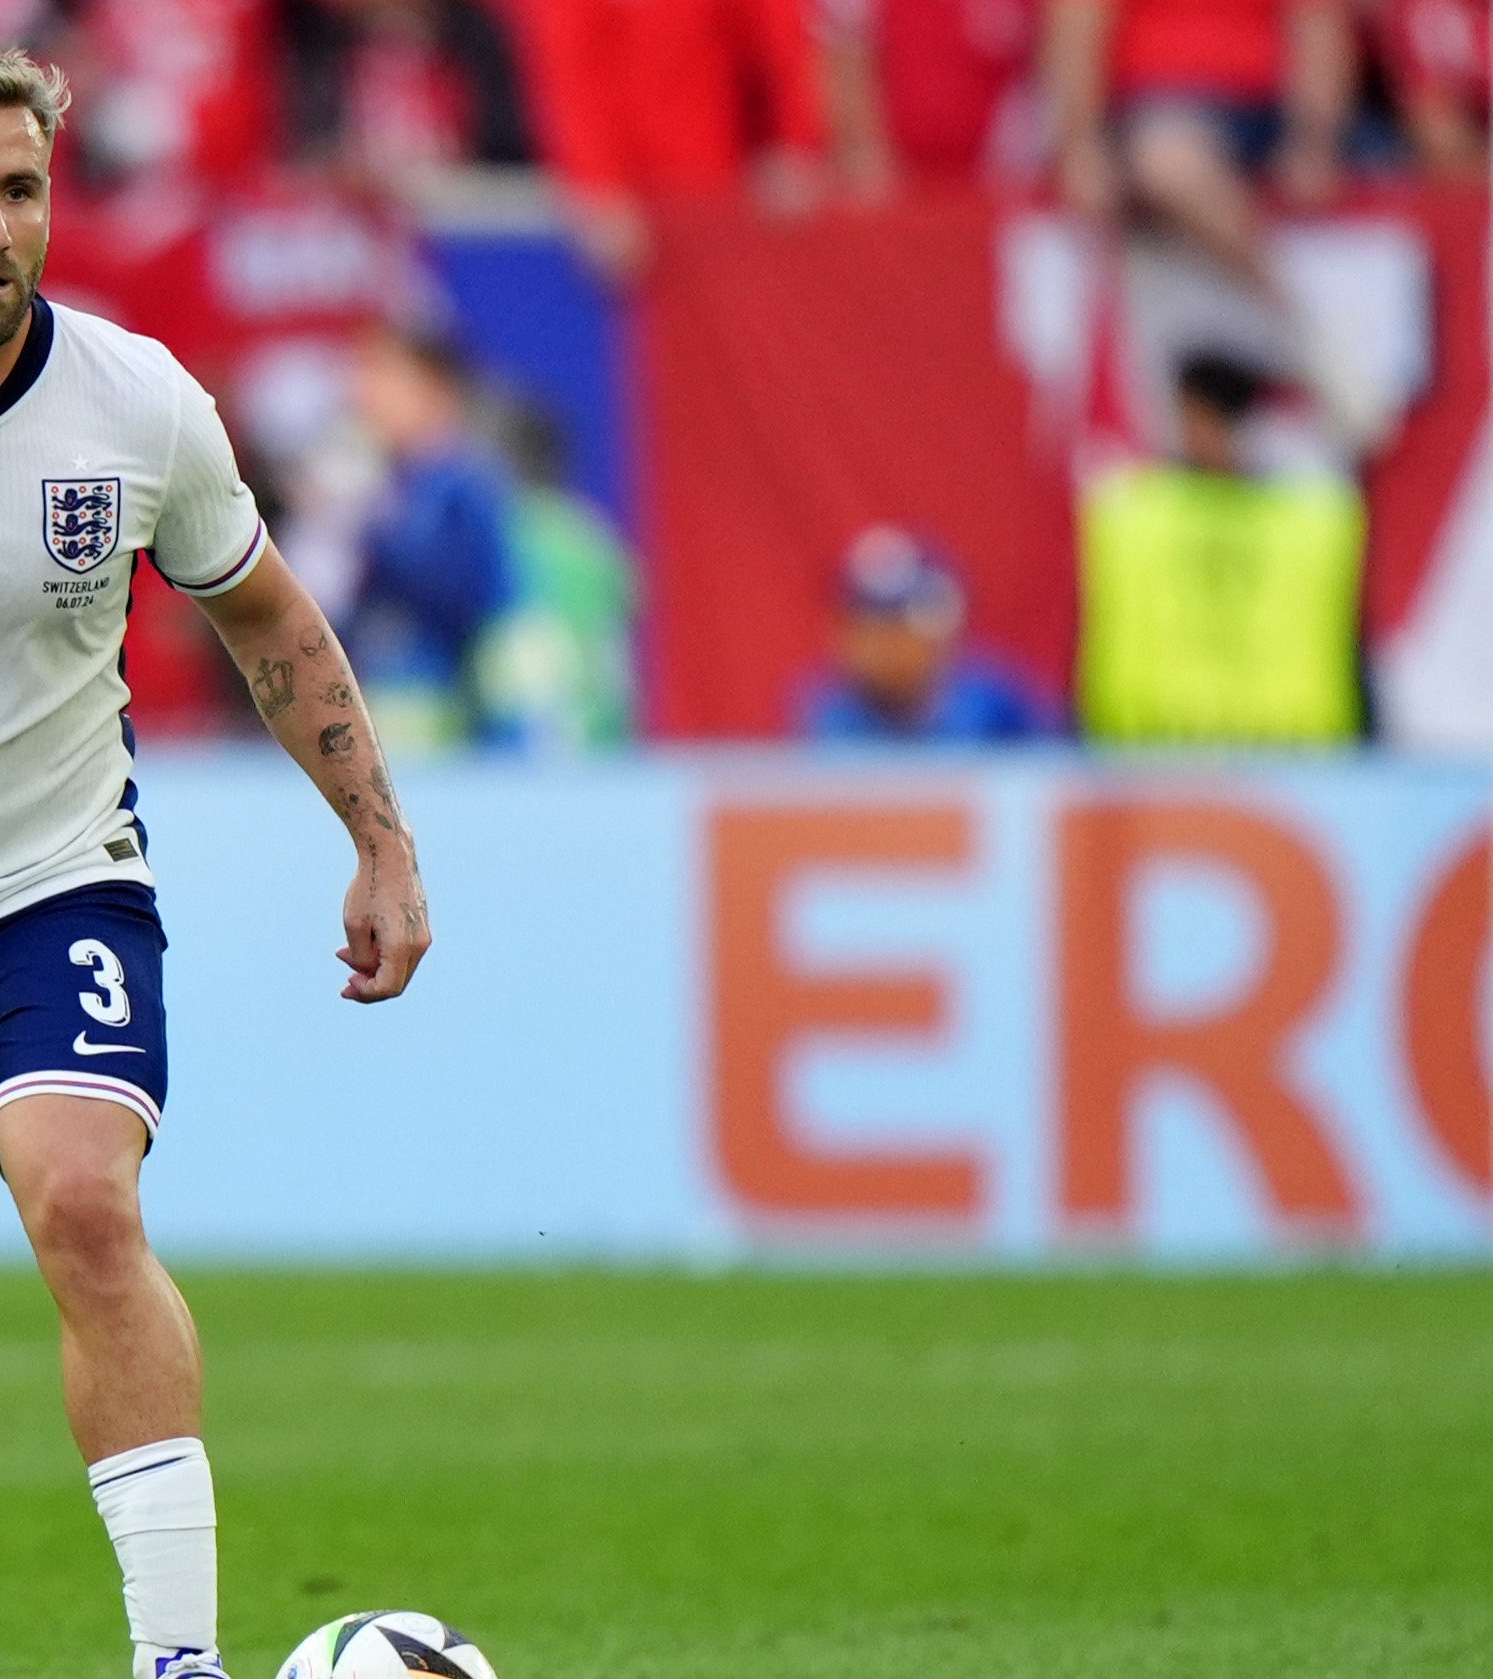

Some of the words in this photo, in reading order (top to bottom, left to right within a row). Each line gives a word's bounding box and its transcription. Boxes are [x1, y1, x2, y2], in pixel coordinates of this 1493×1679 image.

[42, 577, 109, 594] SWITZERLAND
[68, 938, 131, 1028] 3
[704, 798, 1493, 1218] ER
